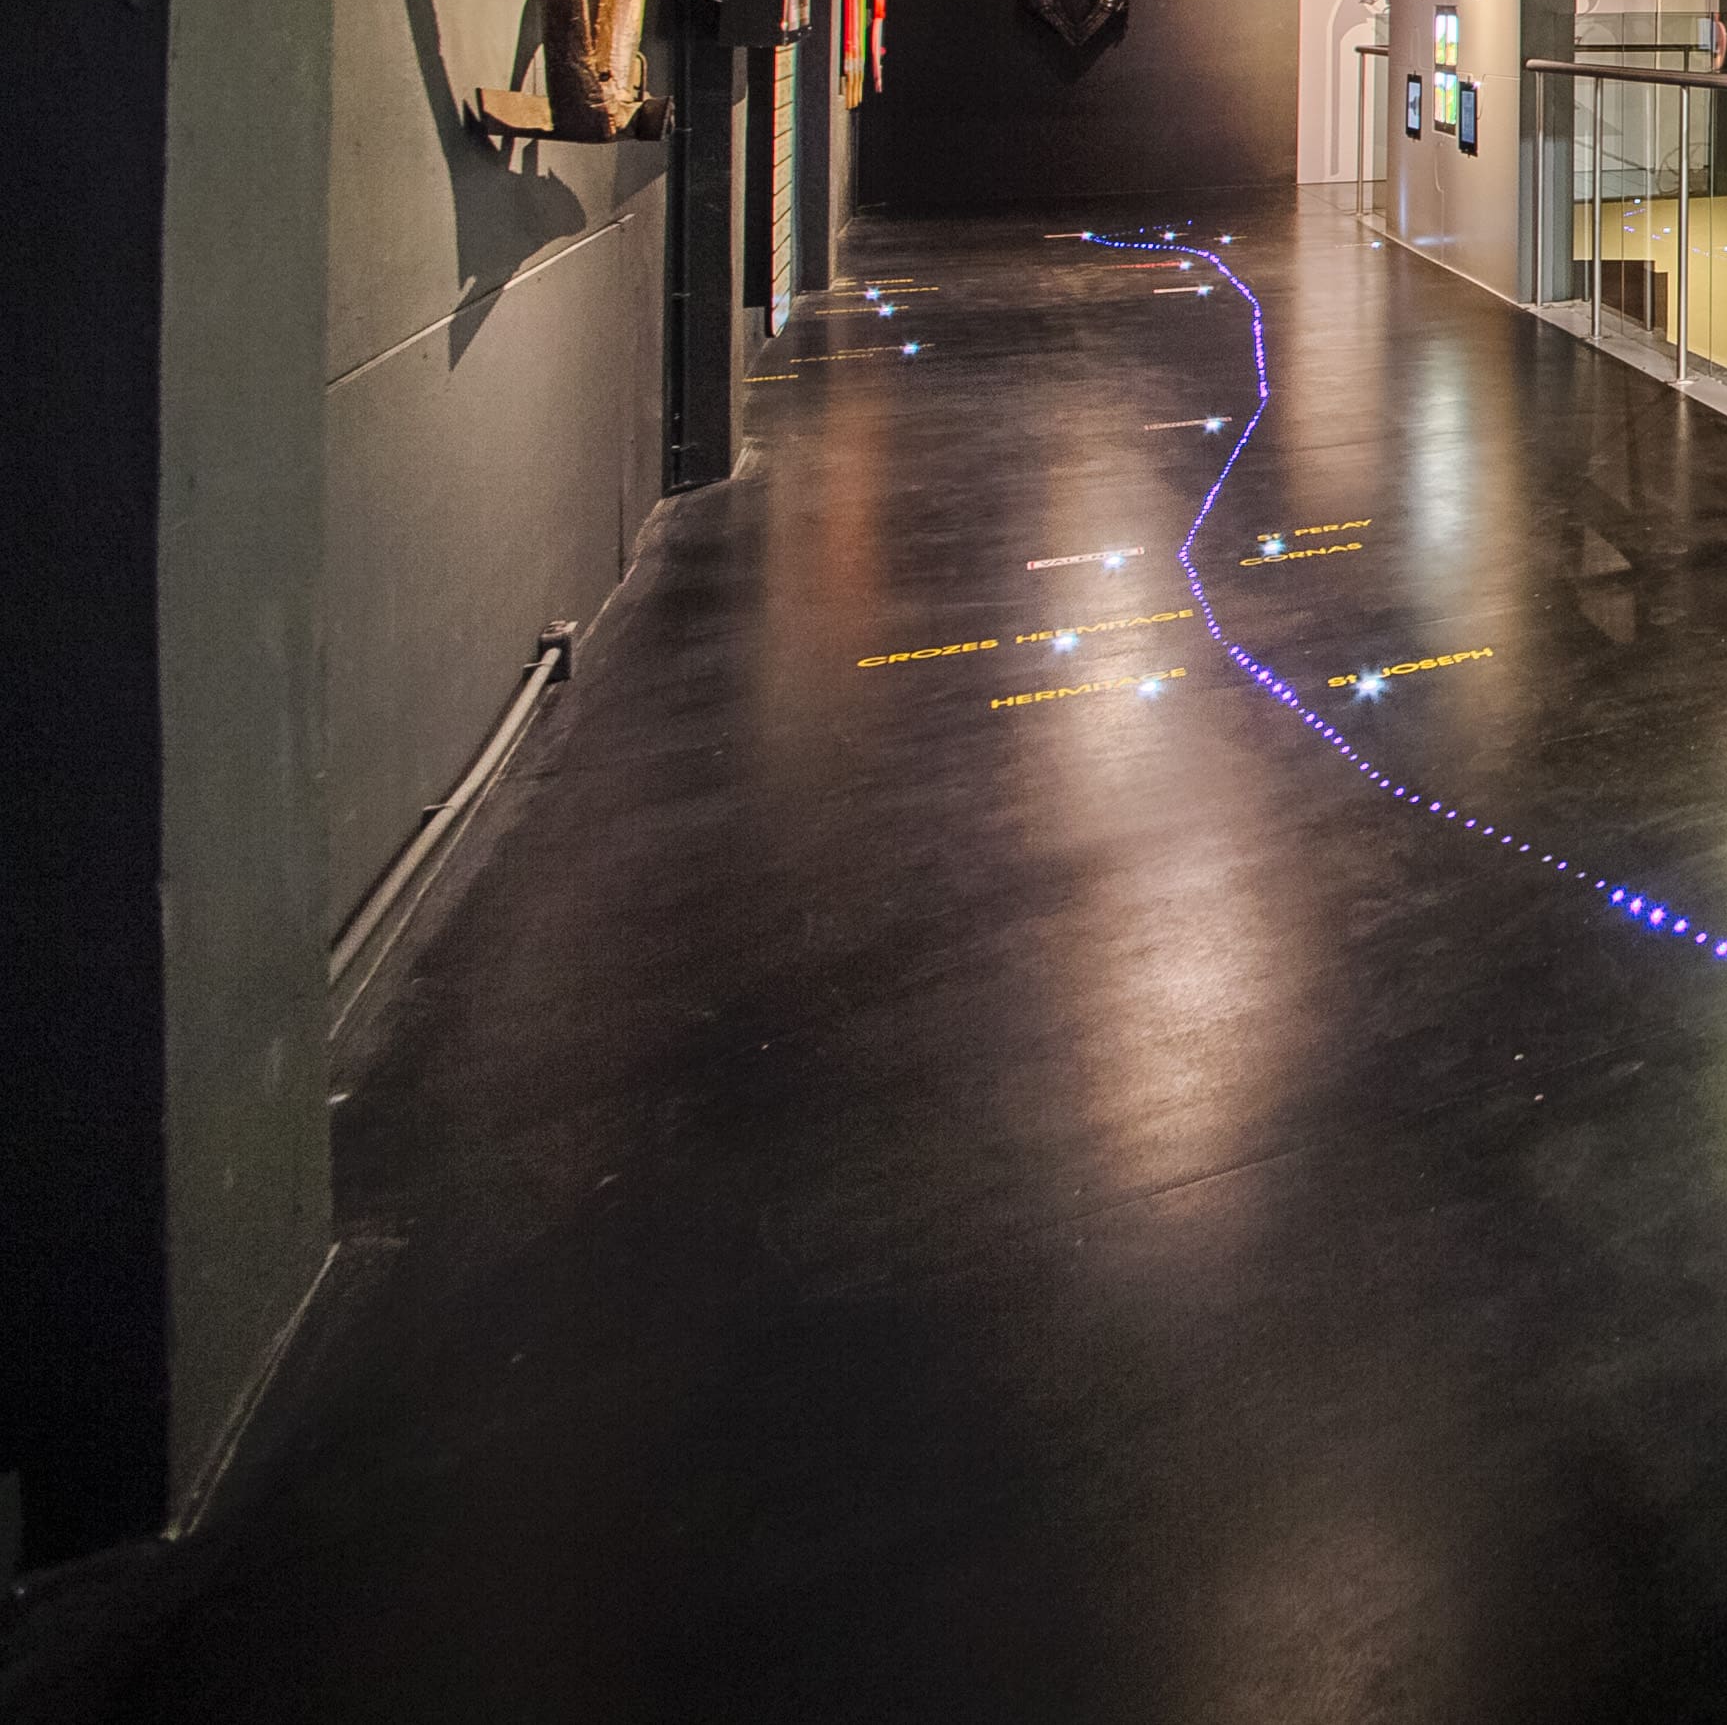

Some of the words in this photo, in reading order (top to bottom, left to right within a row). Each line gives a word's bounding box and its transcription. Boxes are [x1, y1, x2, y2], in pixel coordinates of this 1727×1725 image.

[1294, 518, 1373, 537] PERAY
[1239, 541, 1363, 567] CORNAS
[857, 639, 999, 668] CROZES
[1015, 609, 1194, 644] HERMITAGE
[1327, 673, 1358, 688] St
[1379, 647, 1494, 679] JOSEPH
[989, 667, 1187, 710] HERMITAGE
